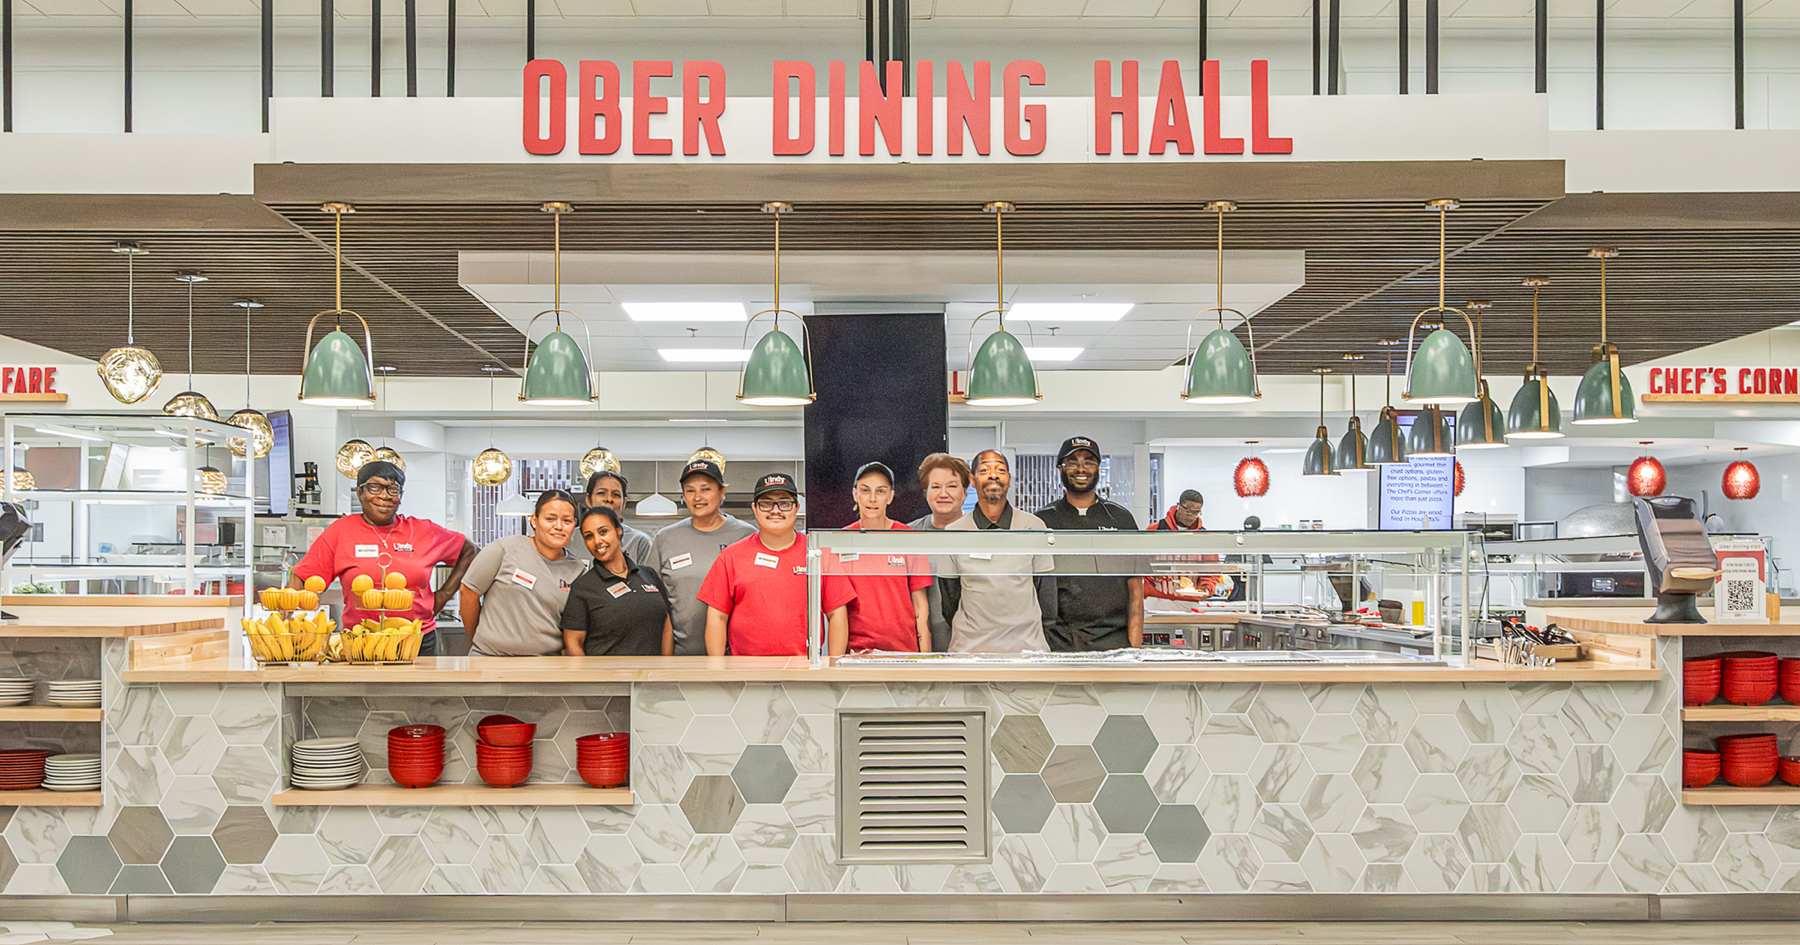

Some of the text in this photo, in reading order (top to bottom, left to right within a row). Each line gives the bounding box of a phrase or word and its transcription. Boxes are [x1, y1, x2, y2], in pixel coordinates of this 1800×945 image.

[523, 59, 1294, 156] OBER DINING HALL
[2, 366, 57, 394] FARE
[1650, 367, 1799, 394] CHEF'S CORN
